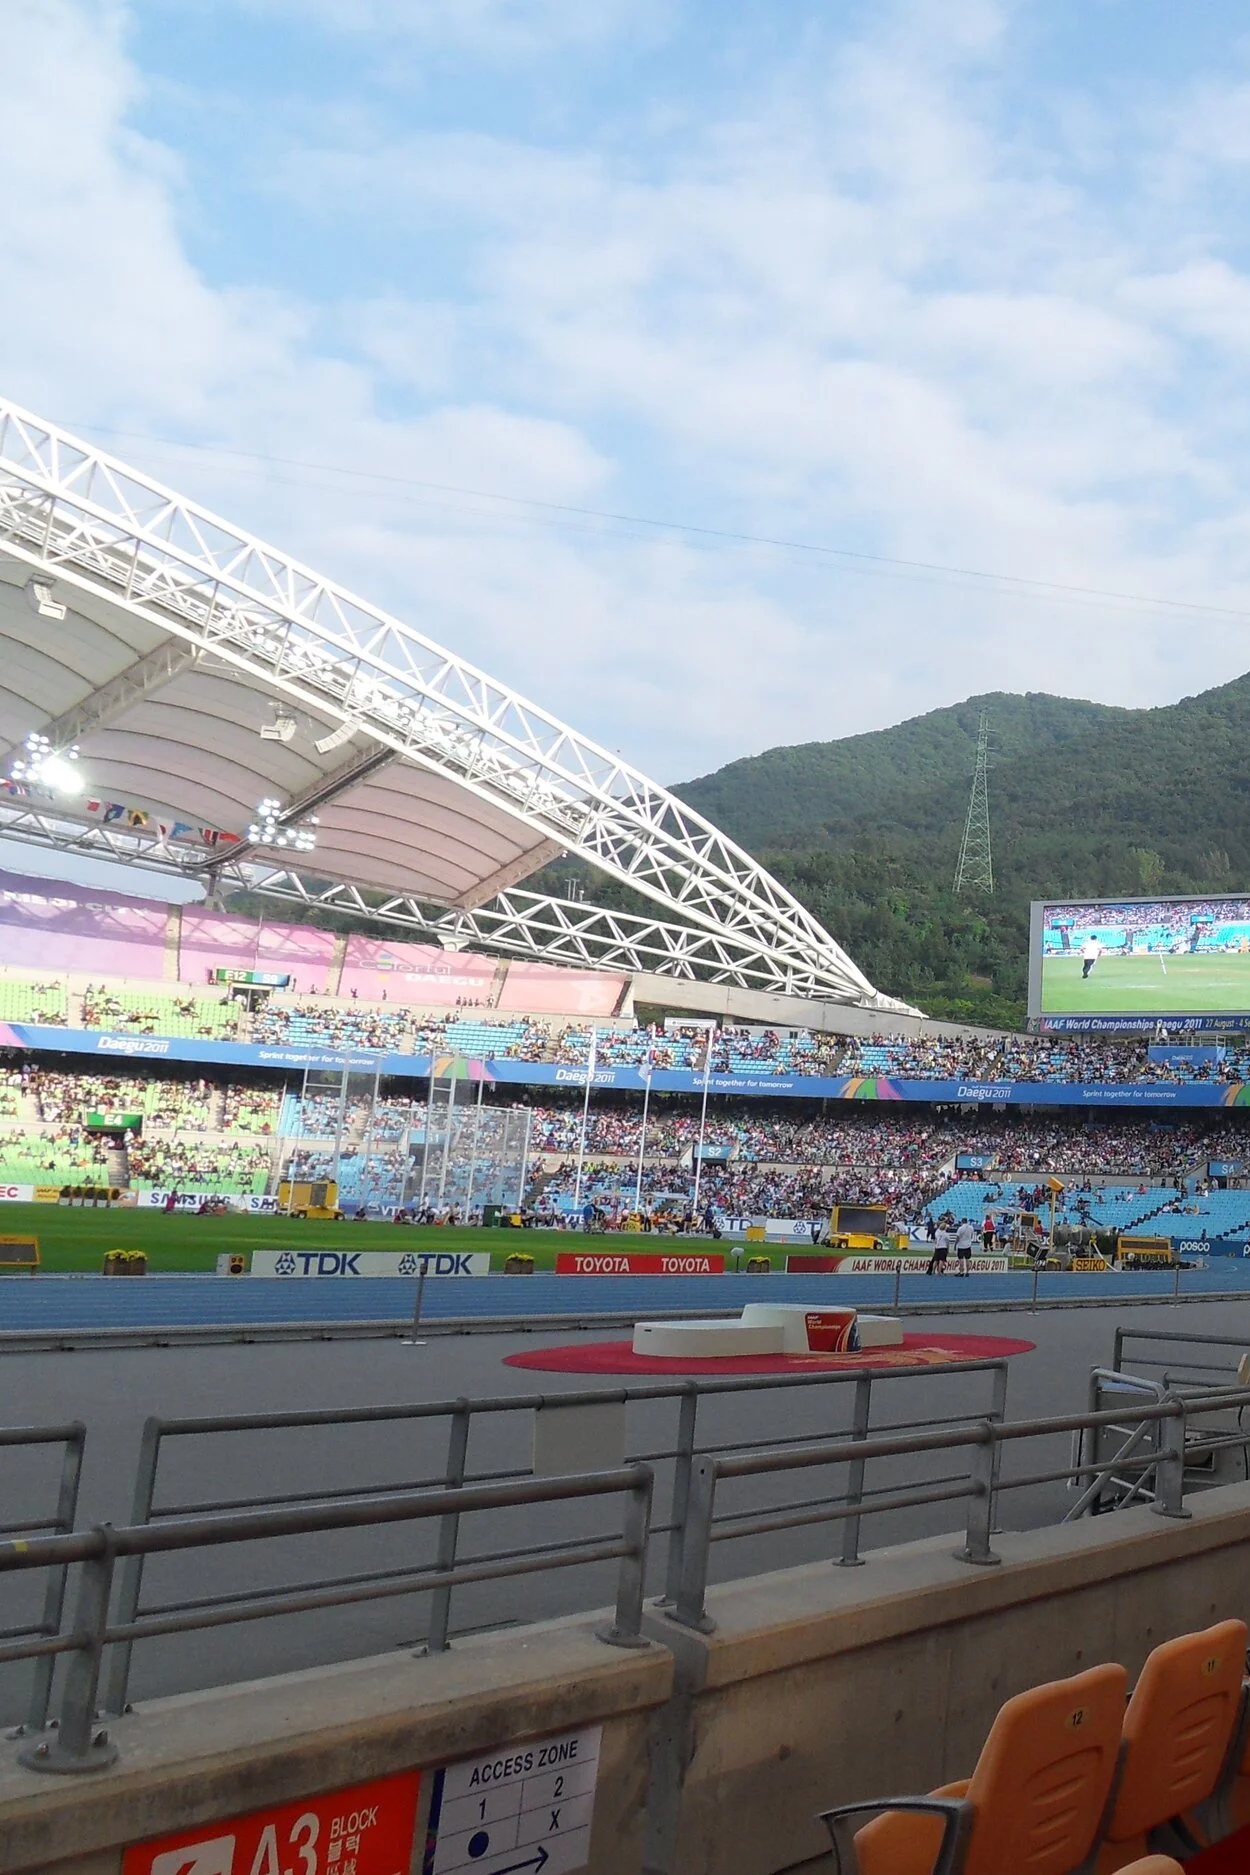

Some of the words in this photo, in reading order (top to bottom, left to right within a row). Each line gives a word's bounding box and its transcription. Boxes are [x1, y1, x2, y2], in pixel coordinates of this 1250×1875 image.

[225, 970, 248, 981] E12
[405, 973, 485, 987] DAEGU
[1044, 1019, 1065, 1030] IAAF
[1066, 1019, 1091, 1030] World
[1091, 1019, 1154, 1031] Championships
[1184, 1019, 1203, 1029] 2011
[1213, 1019, 1235, 1029] August
[97, 1036, 144, 1054] Daegu
[143, 1043, 170, 1053] 2011
[258, 1050, 285, 1061] Sprint
[321, 1054, 334, 1064] for
[594, 1073, 616, 1083] 2011
[715, 1079, 745, 1088] together
[746, 1080, 758, 1088] for
[758, 1081, 794, 1089] tomorrow
[957, 1086, 993, 1100] Daegu
[992, 1089, 1012, 1099] 2011
[1082, 1090, 1103, 1098] Sprint
[1103, 1090, 1132, 1099] together
[1143, 1091, 1177, 1099] tomorrow
[104, 1114, 124, 1126] E4
[708, 1147, 722, 1157] S2
[970, 1157, 983, 1168] S3
[1221, 1164, 1235, 1174] S4
[1179, 1241, 1211, 1253] posco
[297, 1252, 362, 1275] TDK
[417, 1253, 474, 1275] TDK
[575, 1256, 630, 1273] TOYOTA
[661, 1257, 711, 1273] TOYOTA
[851, 1259, 873, 1272] IAAF
[991, 1259, 1005, 1272] 2011
[1075, 1258, 1105, 1272] SEIKO
[1072, 1710, 1083, 1726] 12
[468, 1752, 533, 1787] ACCESS
[538, 1740, 579, 1767] ZONE
[478, 1799, 487, 1820] 1
[553, 1775, 564, 1798] 2
[329, 1805, 379, 1838] BLOCK
[549, 1809, 561, 1831] X
[250, 1812, 320, 1875] A3
[326, 1834, 361, 1863] 블럭
